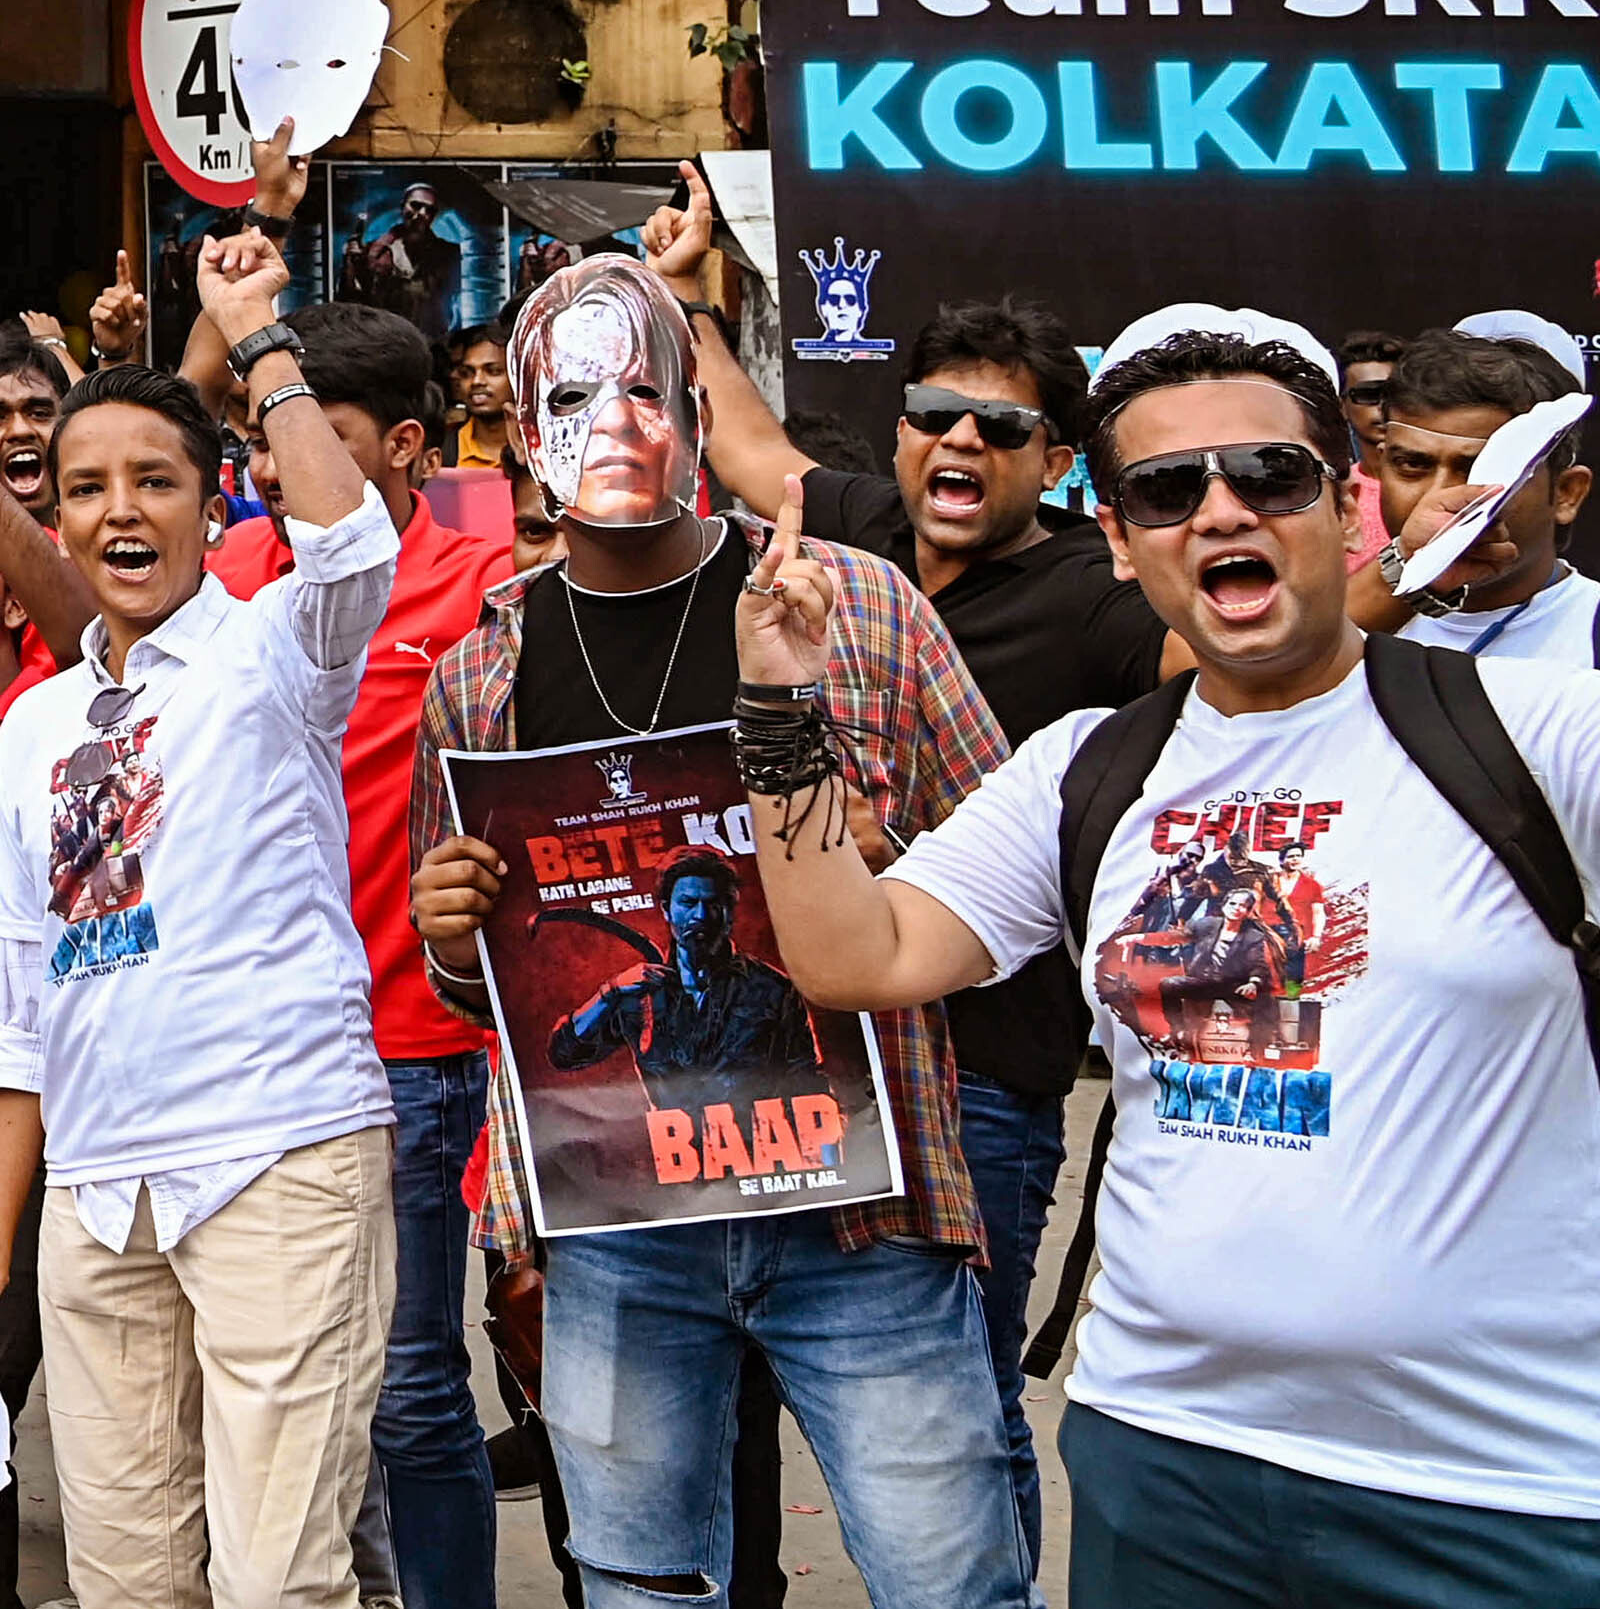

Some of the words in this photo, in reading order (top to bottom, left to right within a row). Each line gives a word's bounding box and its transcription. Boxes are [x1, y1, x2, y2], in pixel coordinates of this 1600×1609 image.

[176, 25, 251, 136] 4
[801, 58, 1600, 174] KOLKATA
[199, 143, 232, 171] Km
[554, 815, 588, 828] TEAM
[590, 808, 626, 823] SHAH
[628, 802, 662, 817] RUKH
[664, 795, 701, 811] KHAN
[1273, 786, 1303, 802] GO
[1150, 799, 1344, 857] CHIEF
[524, 819, 666, 885] BETE
[590, 898, 611, 915] SE
[1150, 1059, 1332, 1138] JAWAN
[646, 1094, 846, 1186] BAAP
[1158, 1120, 1179, 1135] TEAM
[1180, 1124, 1214, 1141] SHAH
[1216, 1129, 1260, 1147] RUKH
[1262, 1135, 1312, 1153] KHAN
[738, 1178, 760, 1196] SE
[761, 1173, 802, 1193] BAAT
